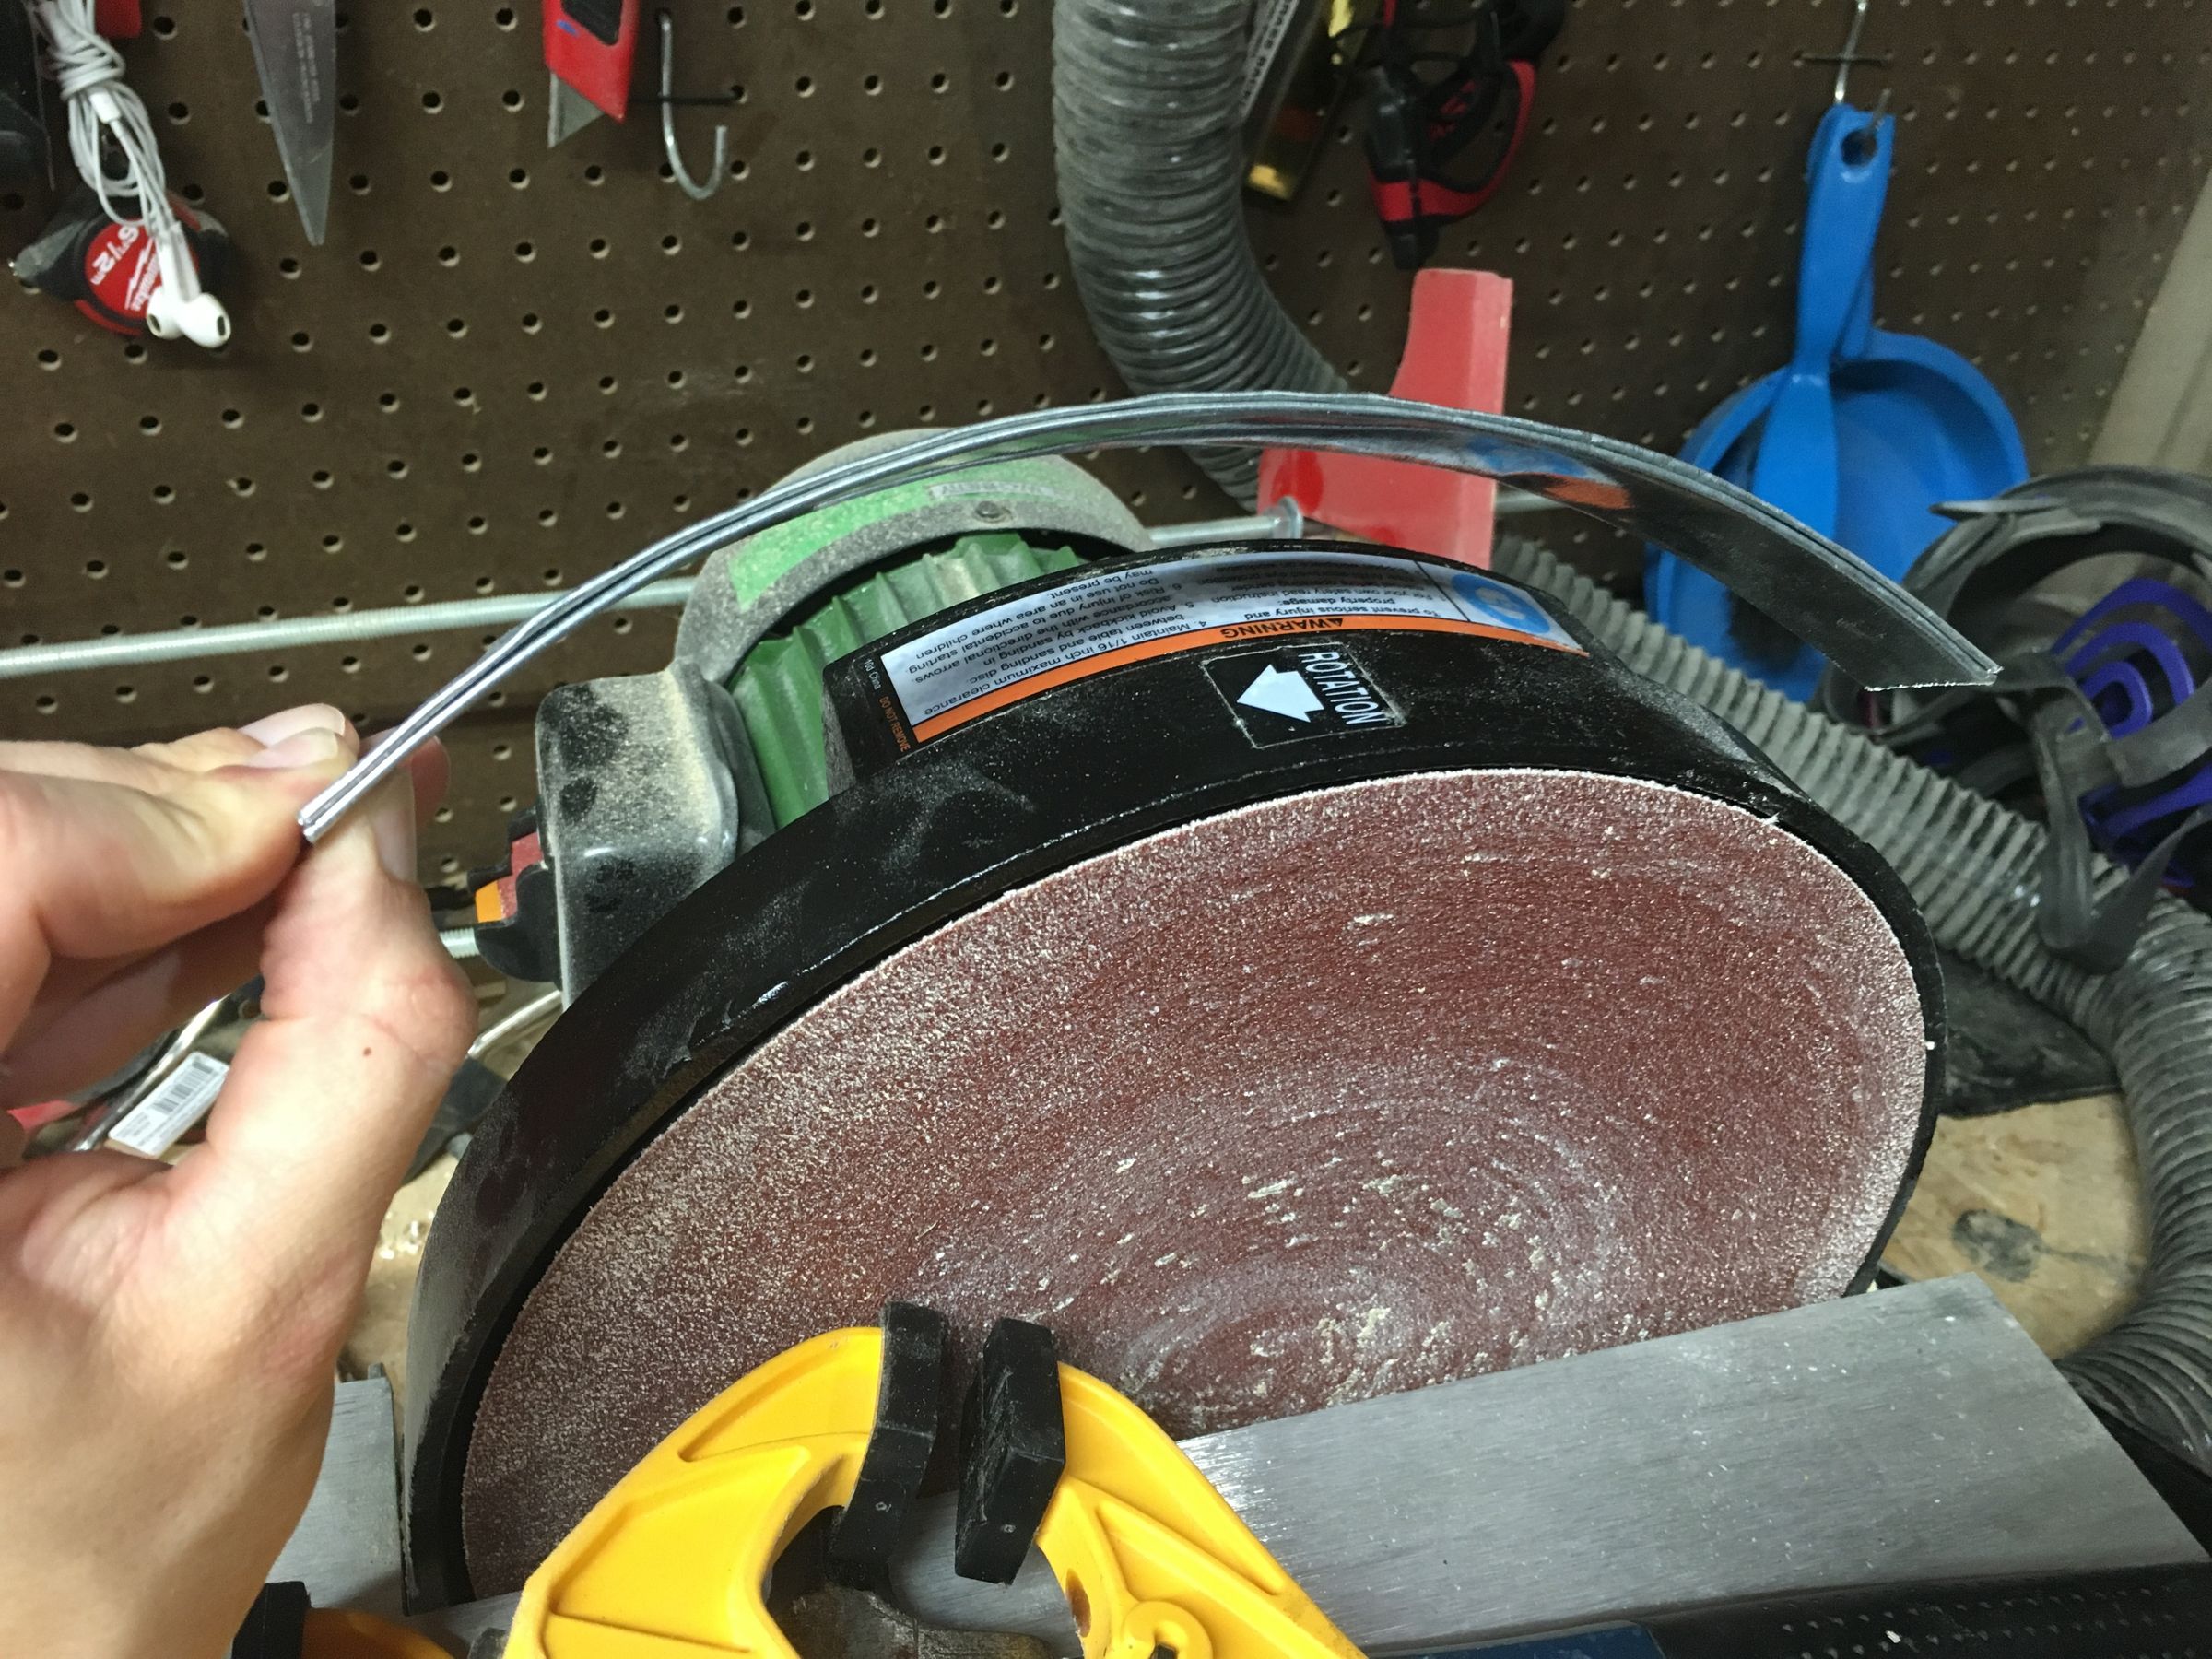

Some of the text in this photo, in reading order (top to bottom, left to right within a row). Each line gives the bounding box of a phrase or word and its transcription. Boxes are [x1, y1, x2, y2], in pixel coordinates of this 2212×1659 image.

[1046, 569, 1153, 599] may be present.
[1315, 587, 1352, 596] safety
[1119, 594, 1131, 604] of
[1135, 586, 1165, 600] Risk
[1211, 590, 1278, 605] instruction
[1284, 589, 1311, 598] read
[1384, 588, 1408, 597] your
[1078, 594, 1116, 611] injury
[1277, 596, 1394, 606] property damage:
[915, 577, 1159, 660] Do not use in an area where children
[1049, 607, 1075, 620] due
[1139, 604, 1176, 618] Avoid
[1244, 612, 1271, 620] and
[1275, 606, 1314, 618] injury
[1032, 617, 1046, 626] to
[1077, 613, 1135, 634] kickback
[1219, 618, 1331, 638] WARNING
[912, 594, 1171, 684] accordance with the directional arrows.
[961, 622, 1029, 653] accidental
[1056, 629, 1073, 643] by
[1131, 623, 1190, 641] Maintain
[965, 614, 1184, 684] between table and sanding disc.
[998, 636, 1053, 660] sanding
[1097, 637, 1127, 651] 1/16
[904, 648, 958, 674] starting.
[983, 656, 994, 667] in
[1065, 646, 1094, 661] inch
[994, 657, 1061, 686] maximum
[869, 671, 882, 690] China
[1298, 652, 1388, 725] ROTATION
[924, 684, 990, 716] clearance
[879, 696, 911, 752] DO NOT REMOVE
